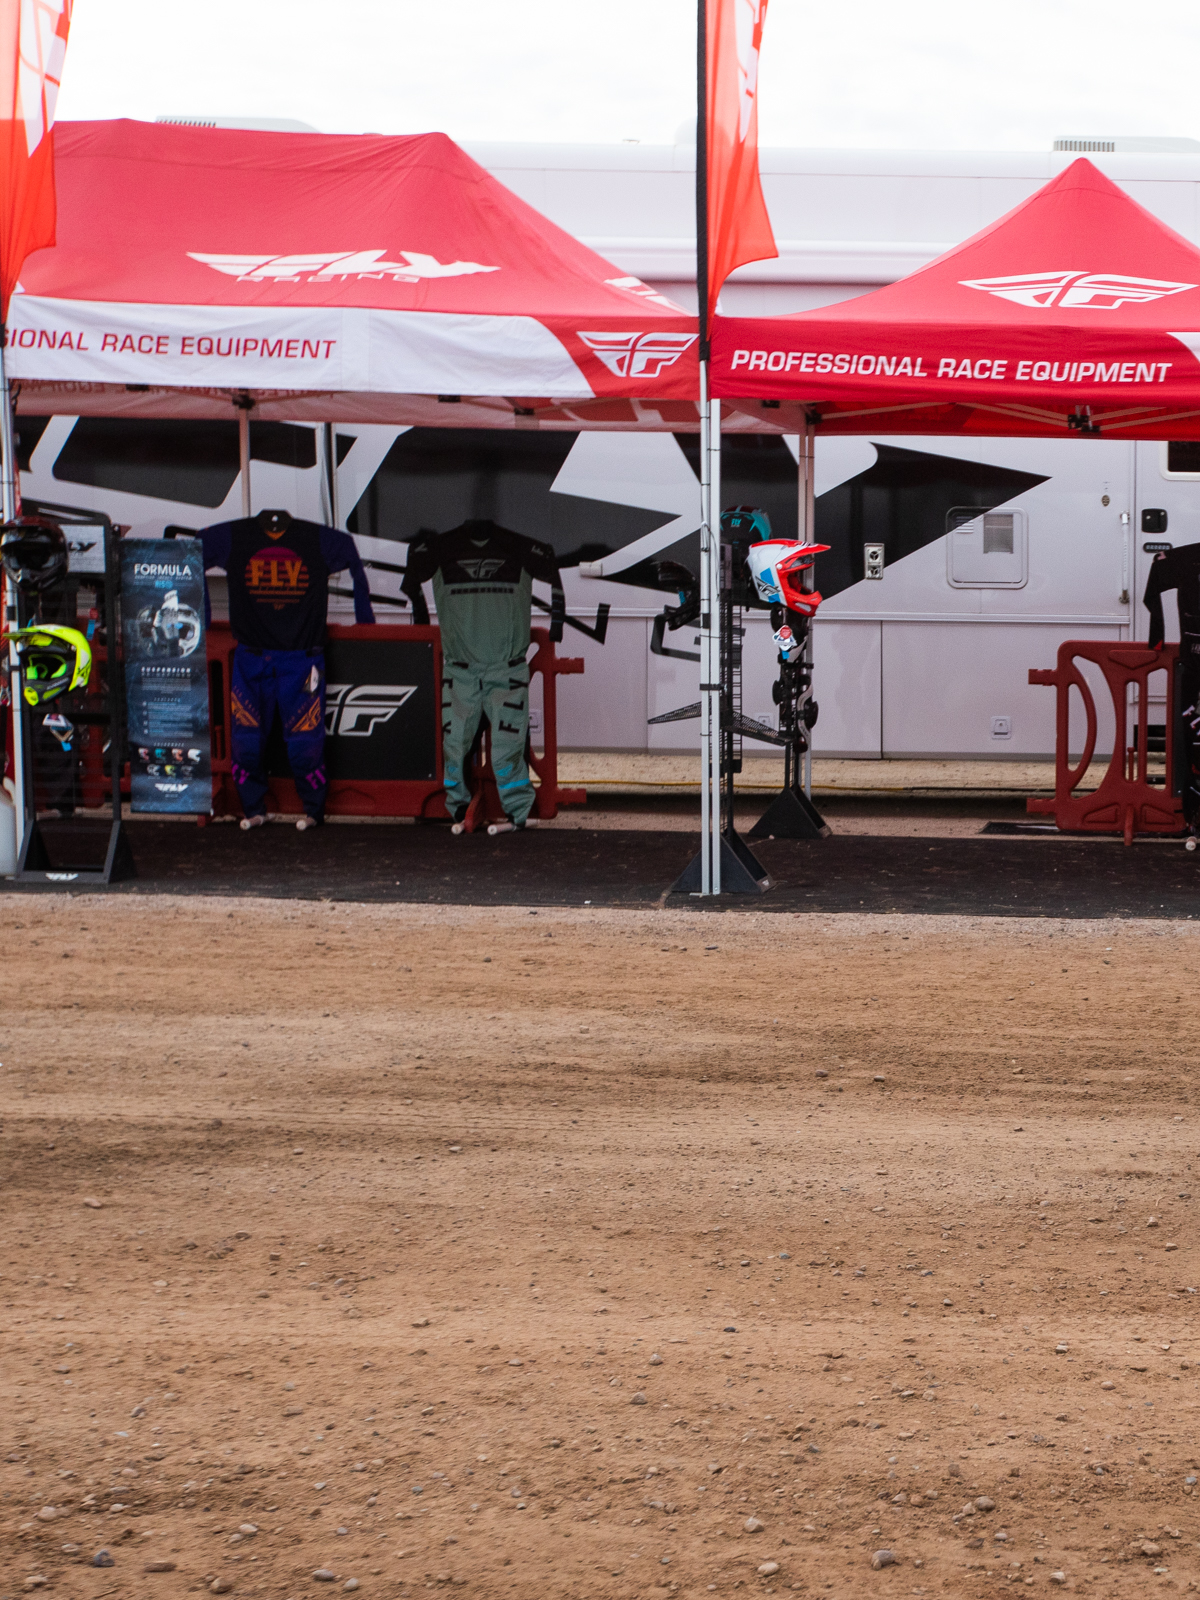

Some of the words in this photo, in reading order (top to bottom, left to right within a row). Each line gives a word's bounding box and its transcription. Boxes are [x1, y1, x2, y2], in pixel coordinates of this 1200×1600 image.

[101, 333, 170, 355] RACE
[180, 335, 337, 359] EQUIPMENT
[731, 349, 928, 378] PROFESSIONAL
[937, 358, 1009, 381] RACE
[1015, 359, 1172, 383] EQUIPMENT
[134, 563, 192, 576] FORMULA
[250, 559, 302, 587] FLY
